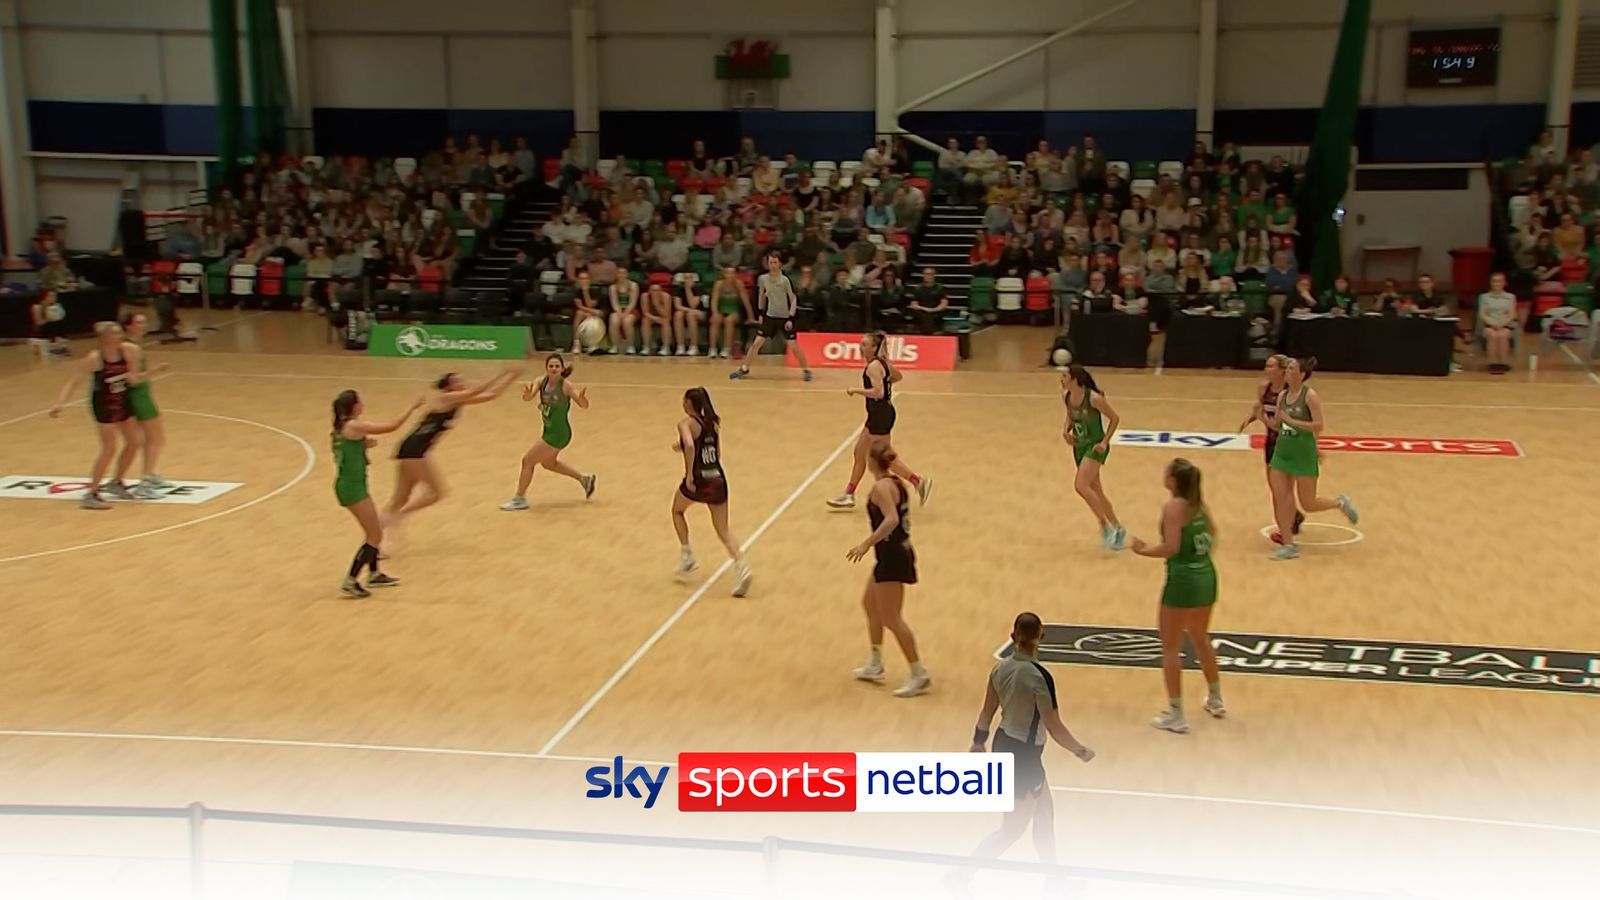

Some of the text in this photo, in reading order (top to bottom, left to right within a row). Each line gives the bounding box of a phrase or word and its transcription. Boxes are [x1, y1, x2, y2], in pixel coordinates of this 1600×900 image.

[428, 339, 498, 351] DRAGONS
[1118, 432, 1502, 453] sky ports
[1210, 638, 1600, 675] NETBAL
[1397, 665, 1600, 688] LEAGU
